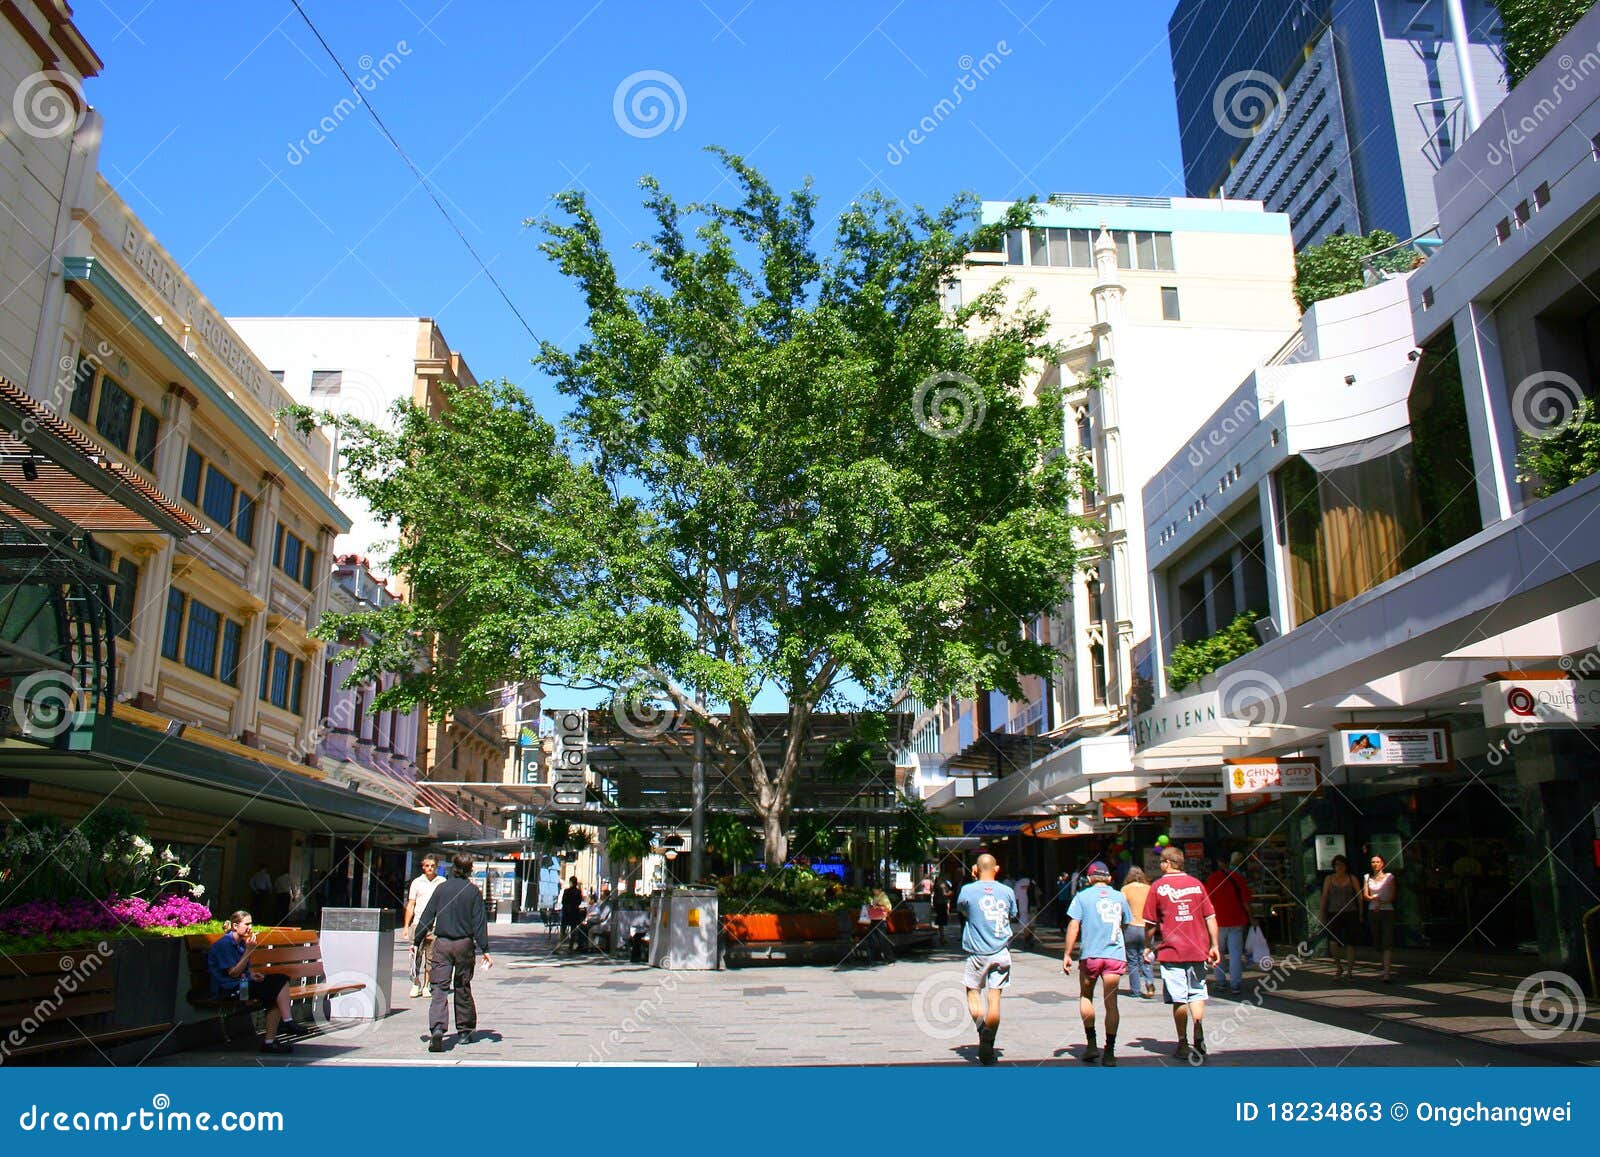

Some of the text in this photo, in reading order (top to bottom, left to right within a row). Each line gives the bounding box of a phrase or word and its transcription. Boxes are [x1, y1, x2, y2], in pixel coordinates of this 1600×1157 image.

[121, 222, 184, 307] BARRY
[200, 315, 263, 392] ROBERTS
[1537, 690, 1585, 709] Quilpie
[1156, 718, 1168, 733] AT
[1175, 704, 1215, 728] LENN
[553, 713, 584, 805] milano
[1246, 767, 1311, 777] CHINA CITY
[1169, 799, 1213, 808] TAILORS
